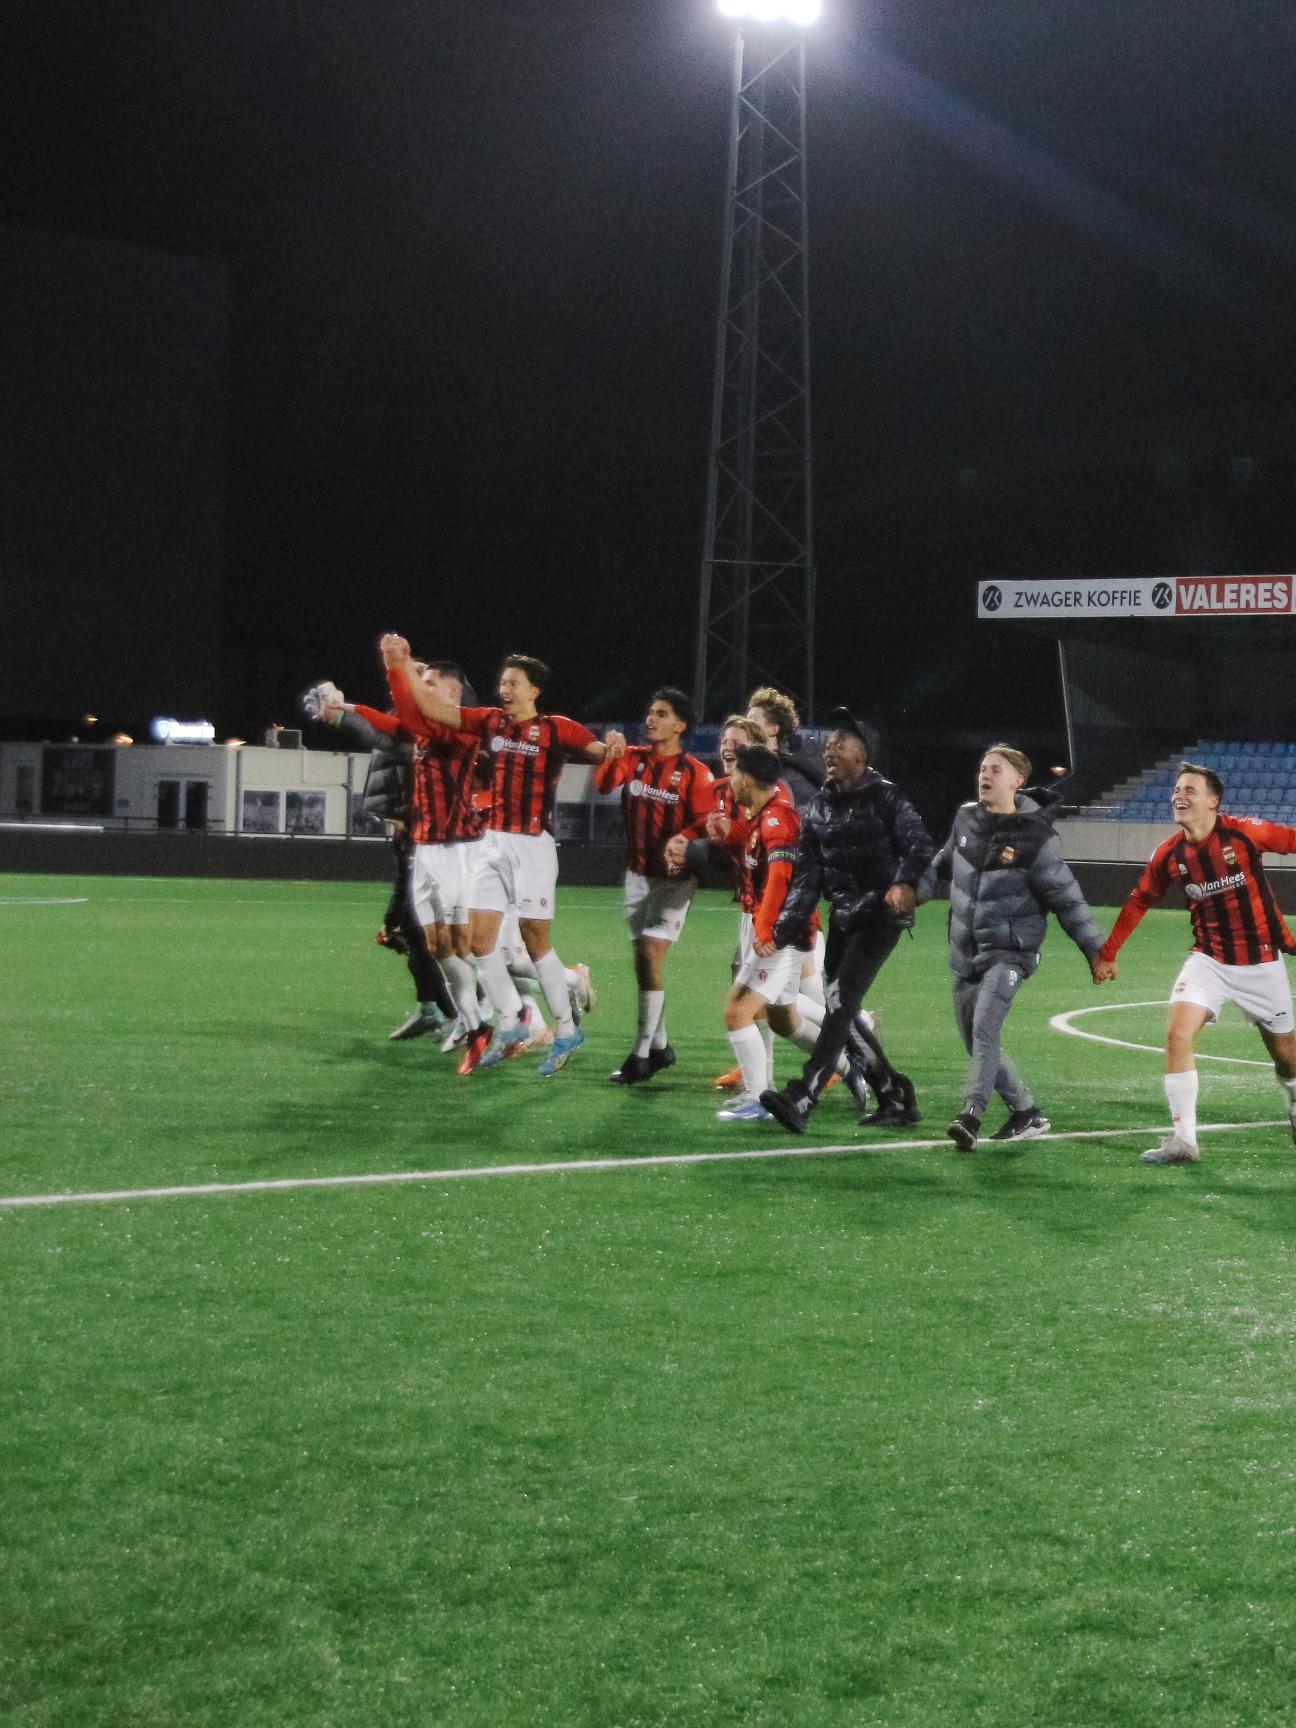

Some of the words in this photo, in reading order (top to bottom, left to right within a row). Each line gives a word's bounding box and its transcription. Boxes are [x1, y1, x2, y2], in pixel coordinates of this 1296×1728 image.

[1014, 591, 1083, 608] ZWAGER
[1087, 590, 1142, 607] KOFFIE
[1179, 582, 1290, 609] VALERES
